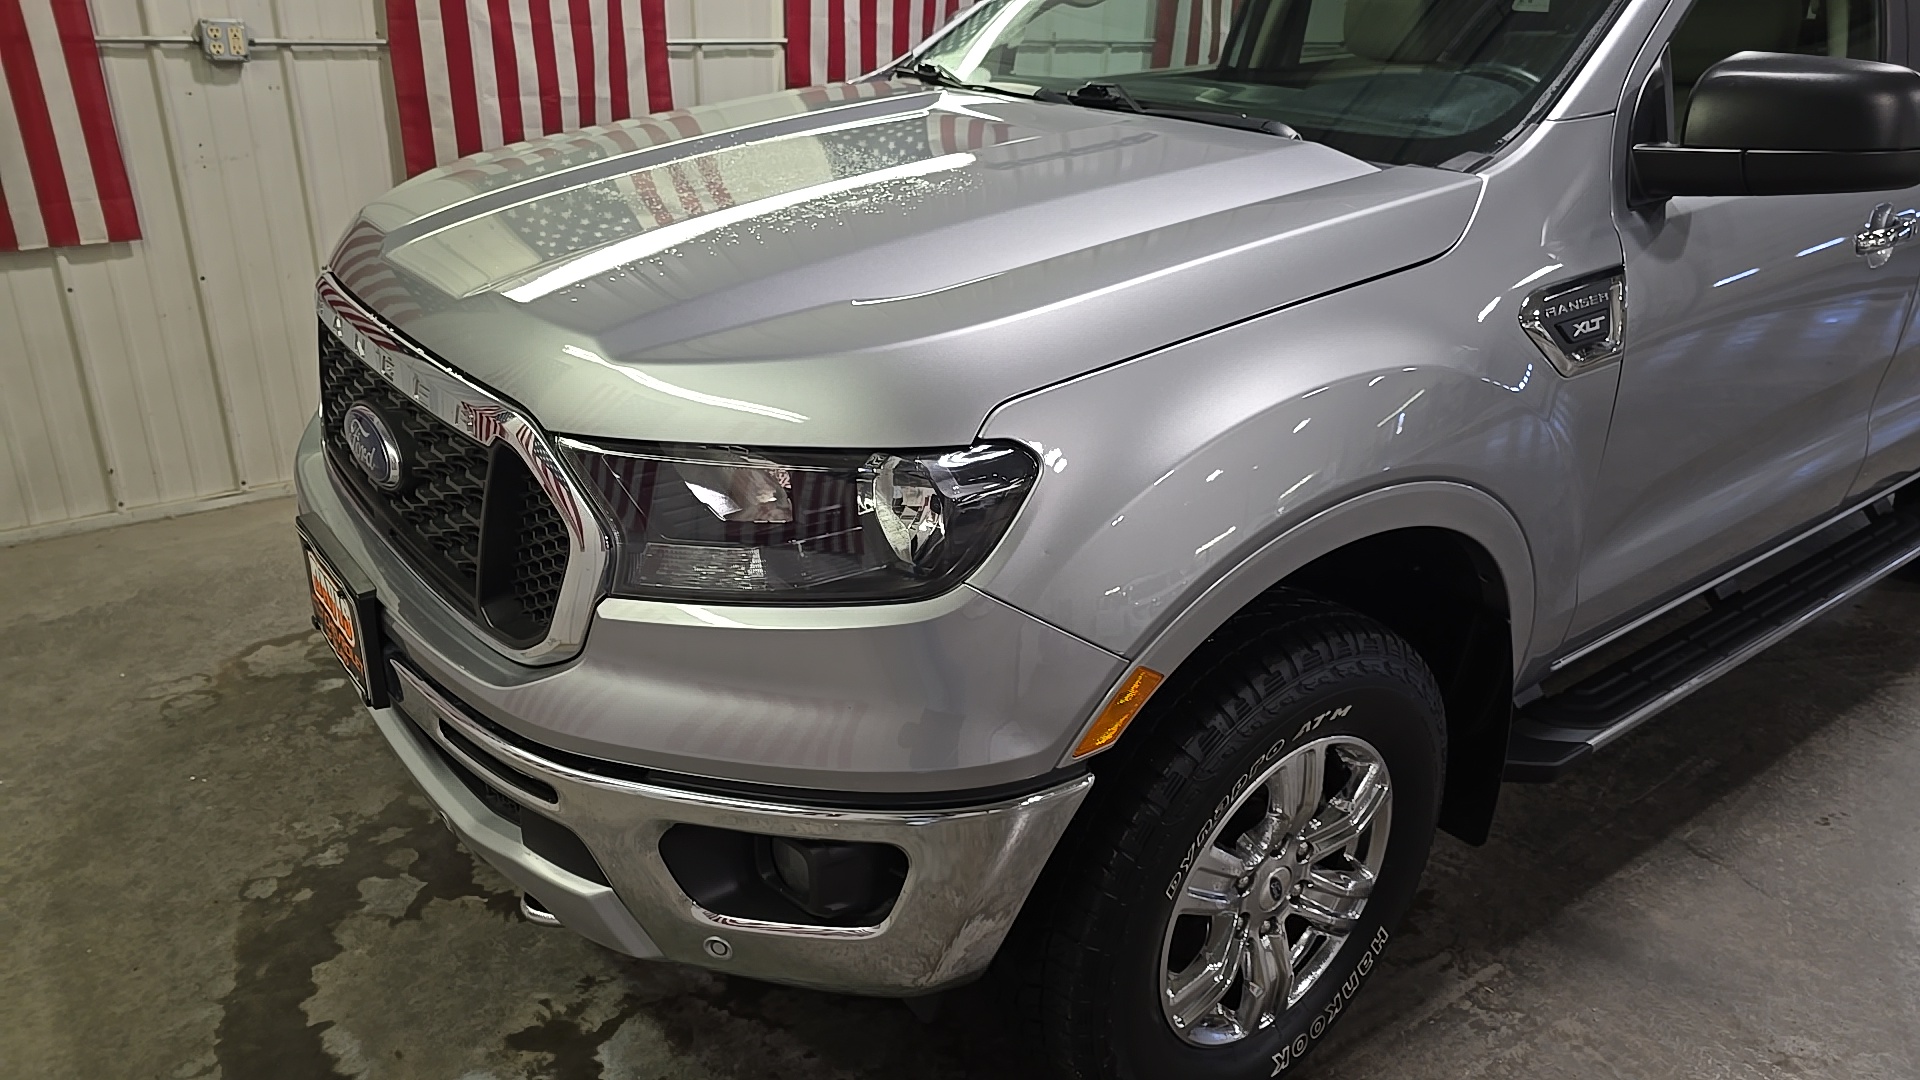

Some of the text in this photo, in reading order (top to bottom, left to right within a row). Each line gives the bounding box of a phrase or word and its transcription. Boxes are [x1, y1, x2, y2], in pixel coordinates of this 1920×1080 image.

[1545, 292, 1609, 318] RANGER
[1573, 315, 1605, 337] XLT
[350, 418, 377, 471] Ford
